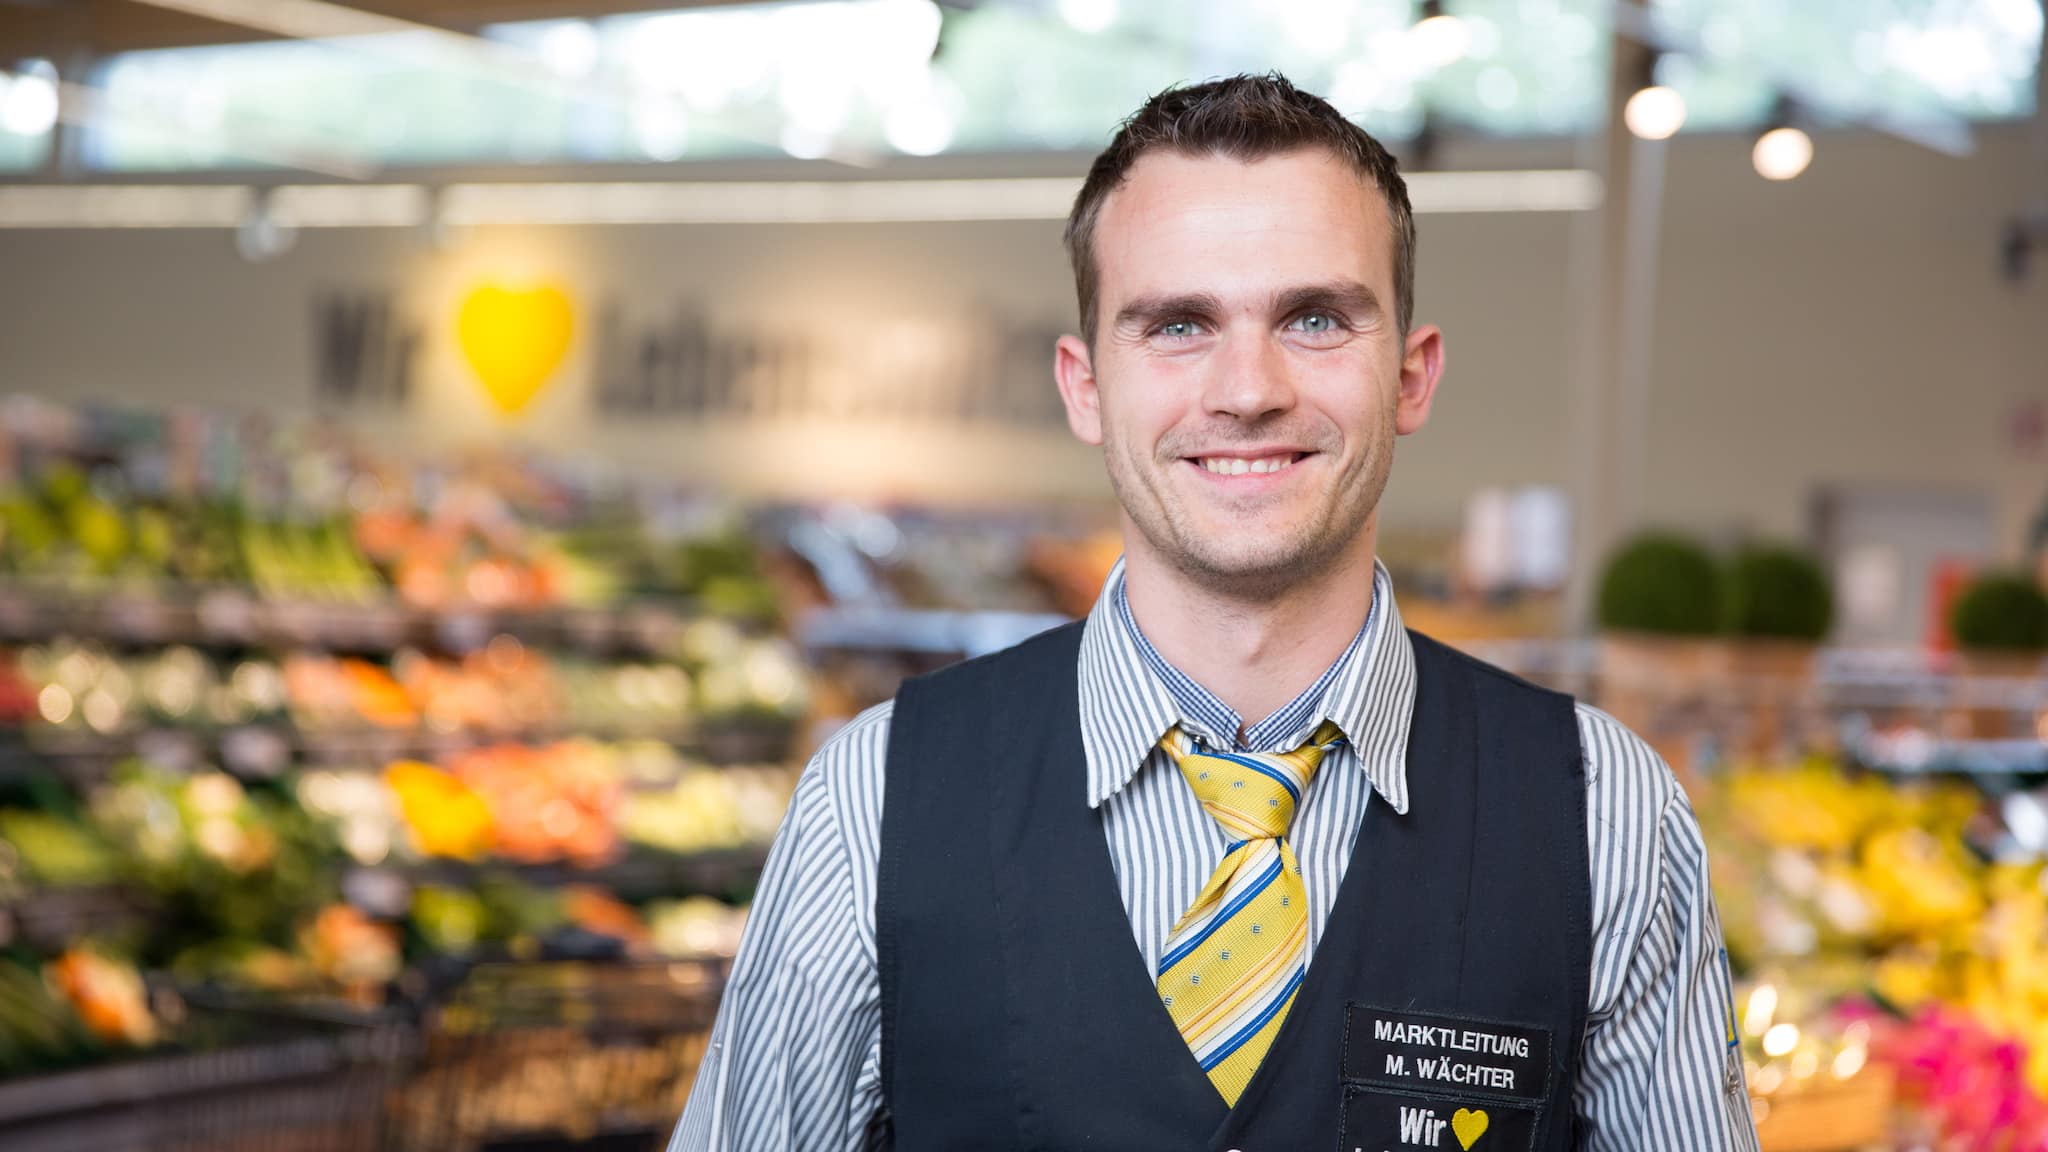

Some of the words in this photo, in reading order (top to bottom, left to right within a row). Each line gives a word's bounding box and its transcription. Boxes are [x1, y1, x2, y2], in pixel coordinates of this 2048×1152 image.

[1374, 1019, 1529, 1058] MARKTLEITUNG
[1385, 1054, 1411, 1076] M.
[1416, 1055, 1515, 1090] WÄCHTER
[1400, 1106, 1447, 1147] Wir
